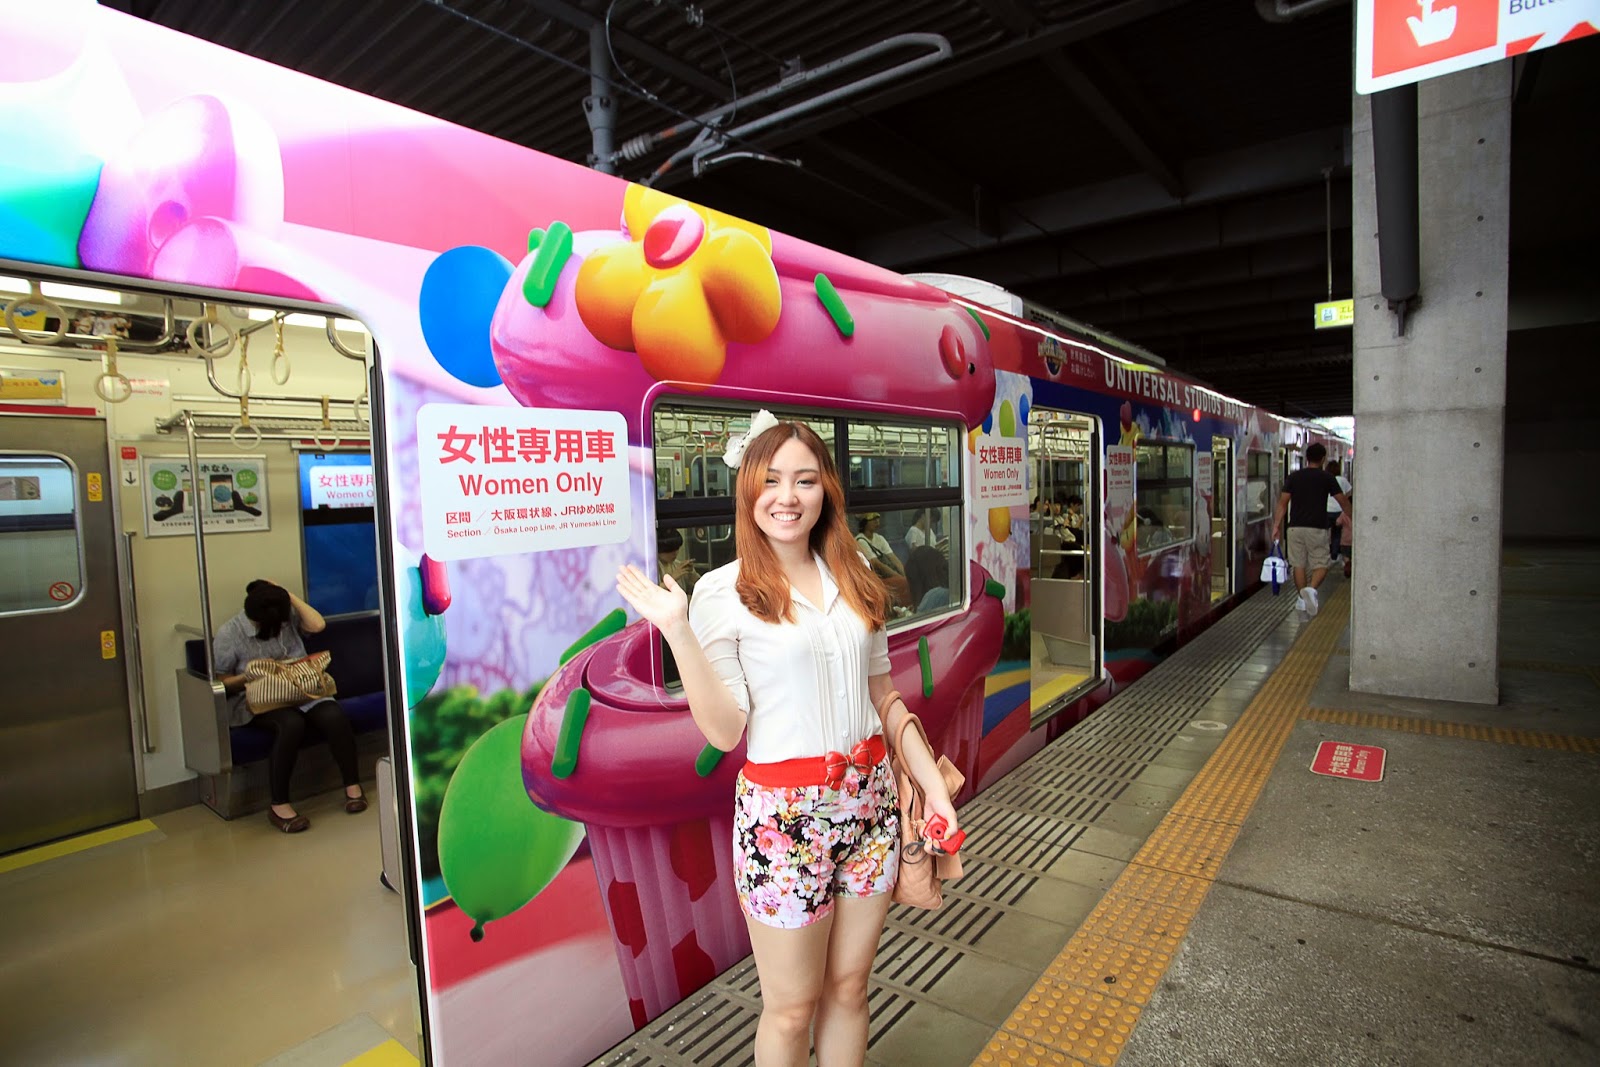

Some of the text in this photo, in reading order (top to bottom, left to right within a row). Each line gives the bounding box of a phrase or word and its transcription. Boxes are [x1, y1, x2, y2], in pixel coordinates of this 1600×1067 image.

[1104, 358, 1181, 405] UNIVERSAL
[1184, 385, 1221, 416] STUDIOS
[437, 425, 616, 464] 女性専用車
[979, 446, 1022, 465] 女性専用車
[180, 464, 234, 473] スホなら、
[984, 468, 1019, 480] Women Only
[458, 472, 603, 497] Women Only
[326, 490, 364, 499] Women
[446, 511, 471, 525] 区間
[447, 528, 482, 538] Section
[519, 525, 539, 533] Loop
[570, 520, 601, 529] Yumesaki
[602, 518, 617, 526] Line
